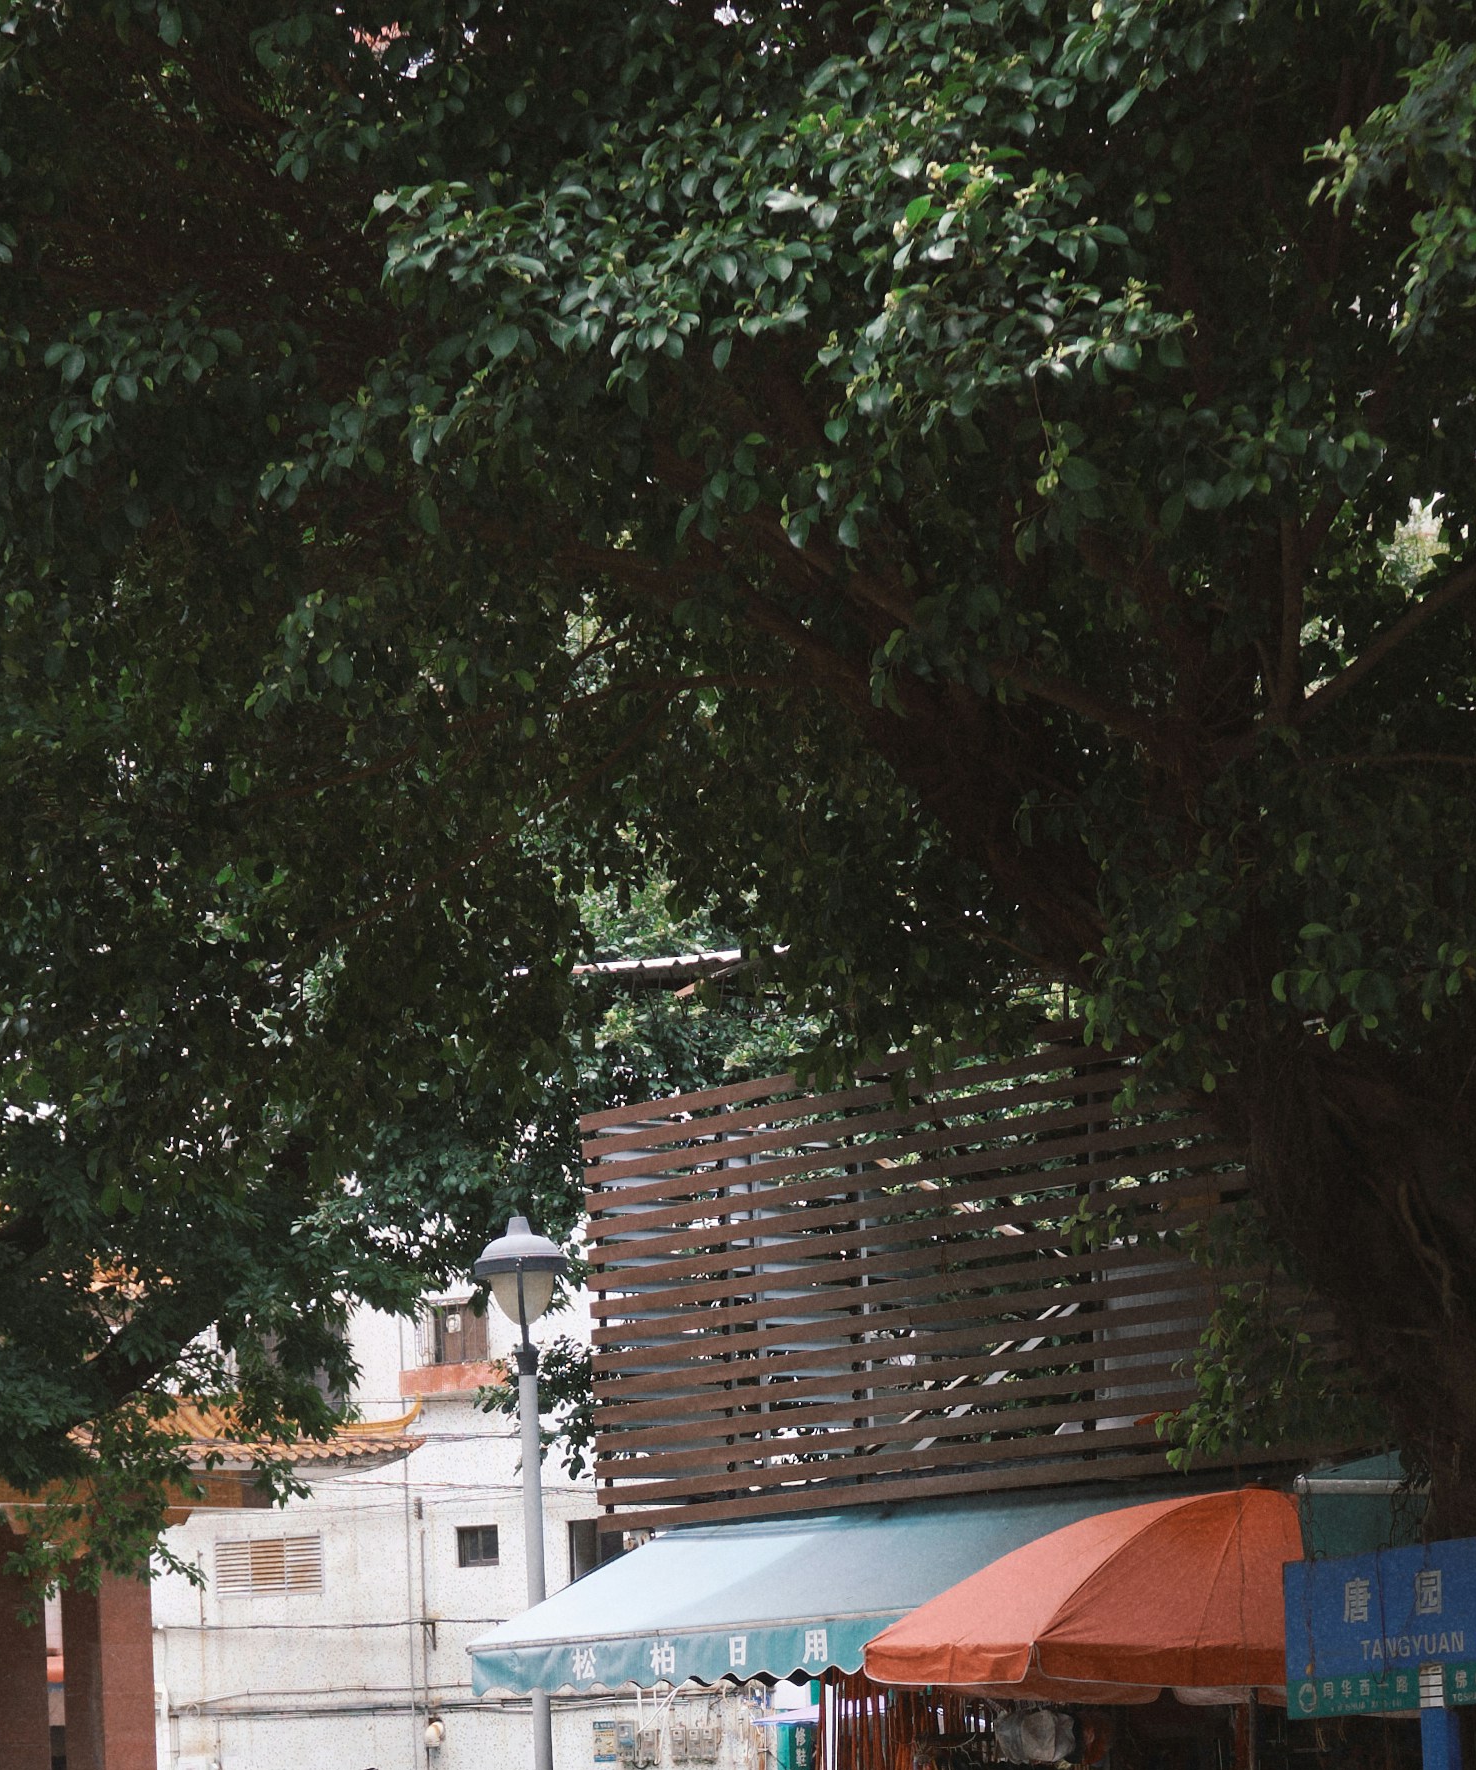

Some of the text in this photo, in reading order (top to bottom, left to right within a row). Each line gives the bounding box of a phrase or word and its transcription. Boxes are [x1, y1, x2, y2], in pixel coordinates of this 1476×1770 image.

[571, 1628, 828, 1682] 松柏日用
[1360, 1630, 1465, 1662] TANGYUAN
